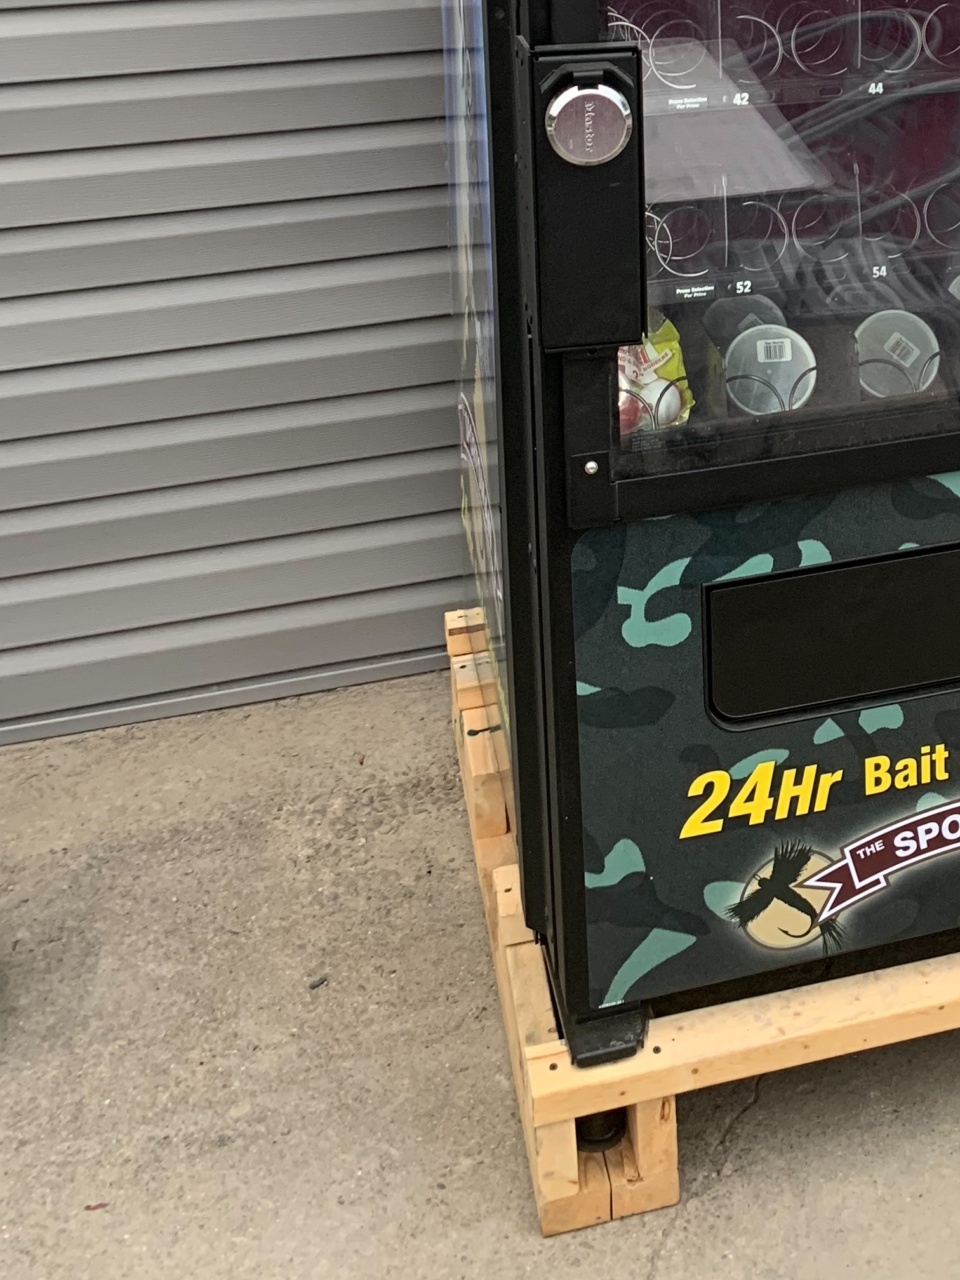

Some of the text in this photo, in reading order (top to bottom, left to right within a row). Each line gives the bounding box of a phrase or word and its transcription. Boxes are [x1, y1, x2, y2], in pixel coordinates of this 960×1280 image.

[868, 82, 884, 95] 44
[732, 92, 749, 106] 42
[872, 266, 887, 278] 54
[736, 280, 752, 294] 52
[678, 760, 842, 839] 24Hr
[864, 742, 950, 796] Bait
[856, 839, 885, 859] THE
